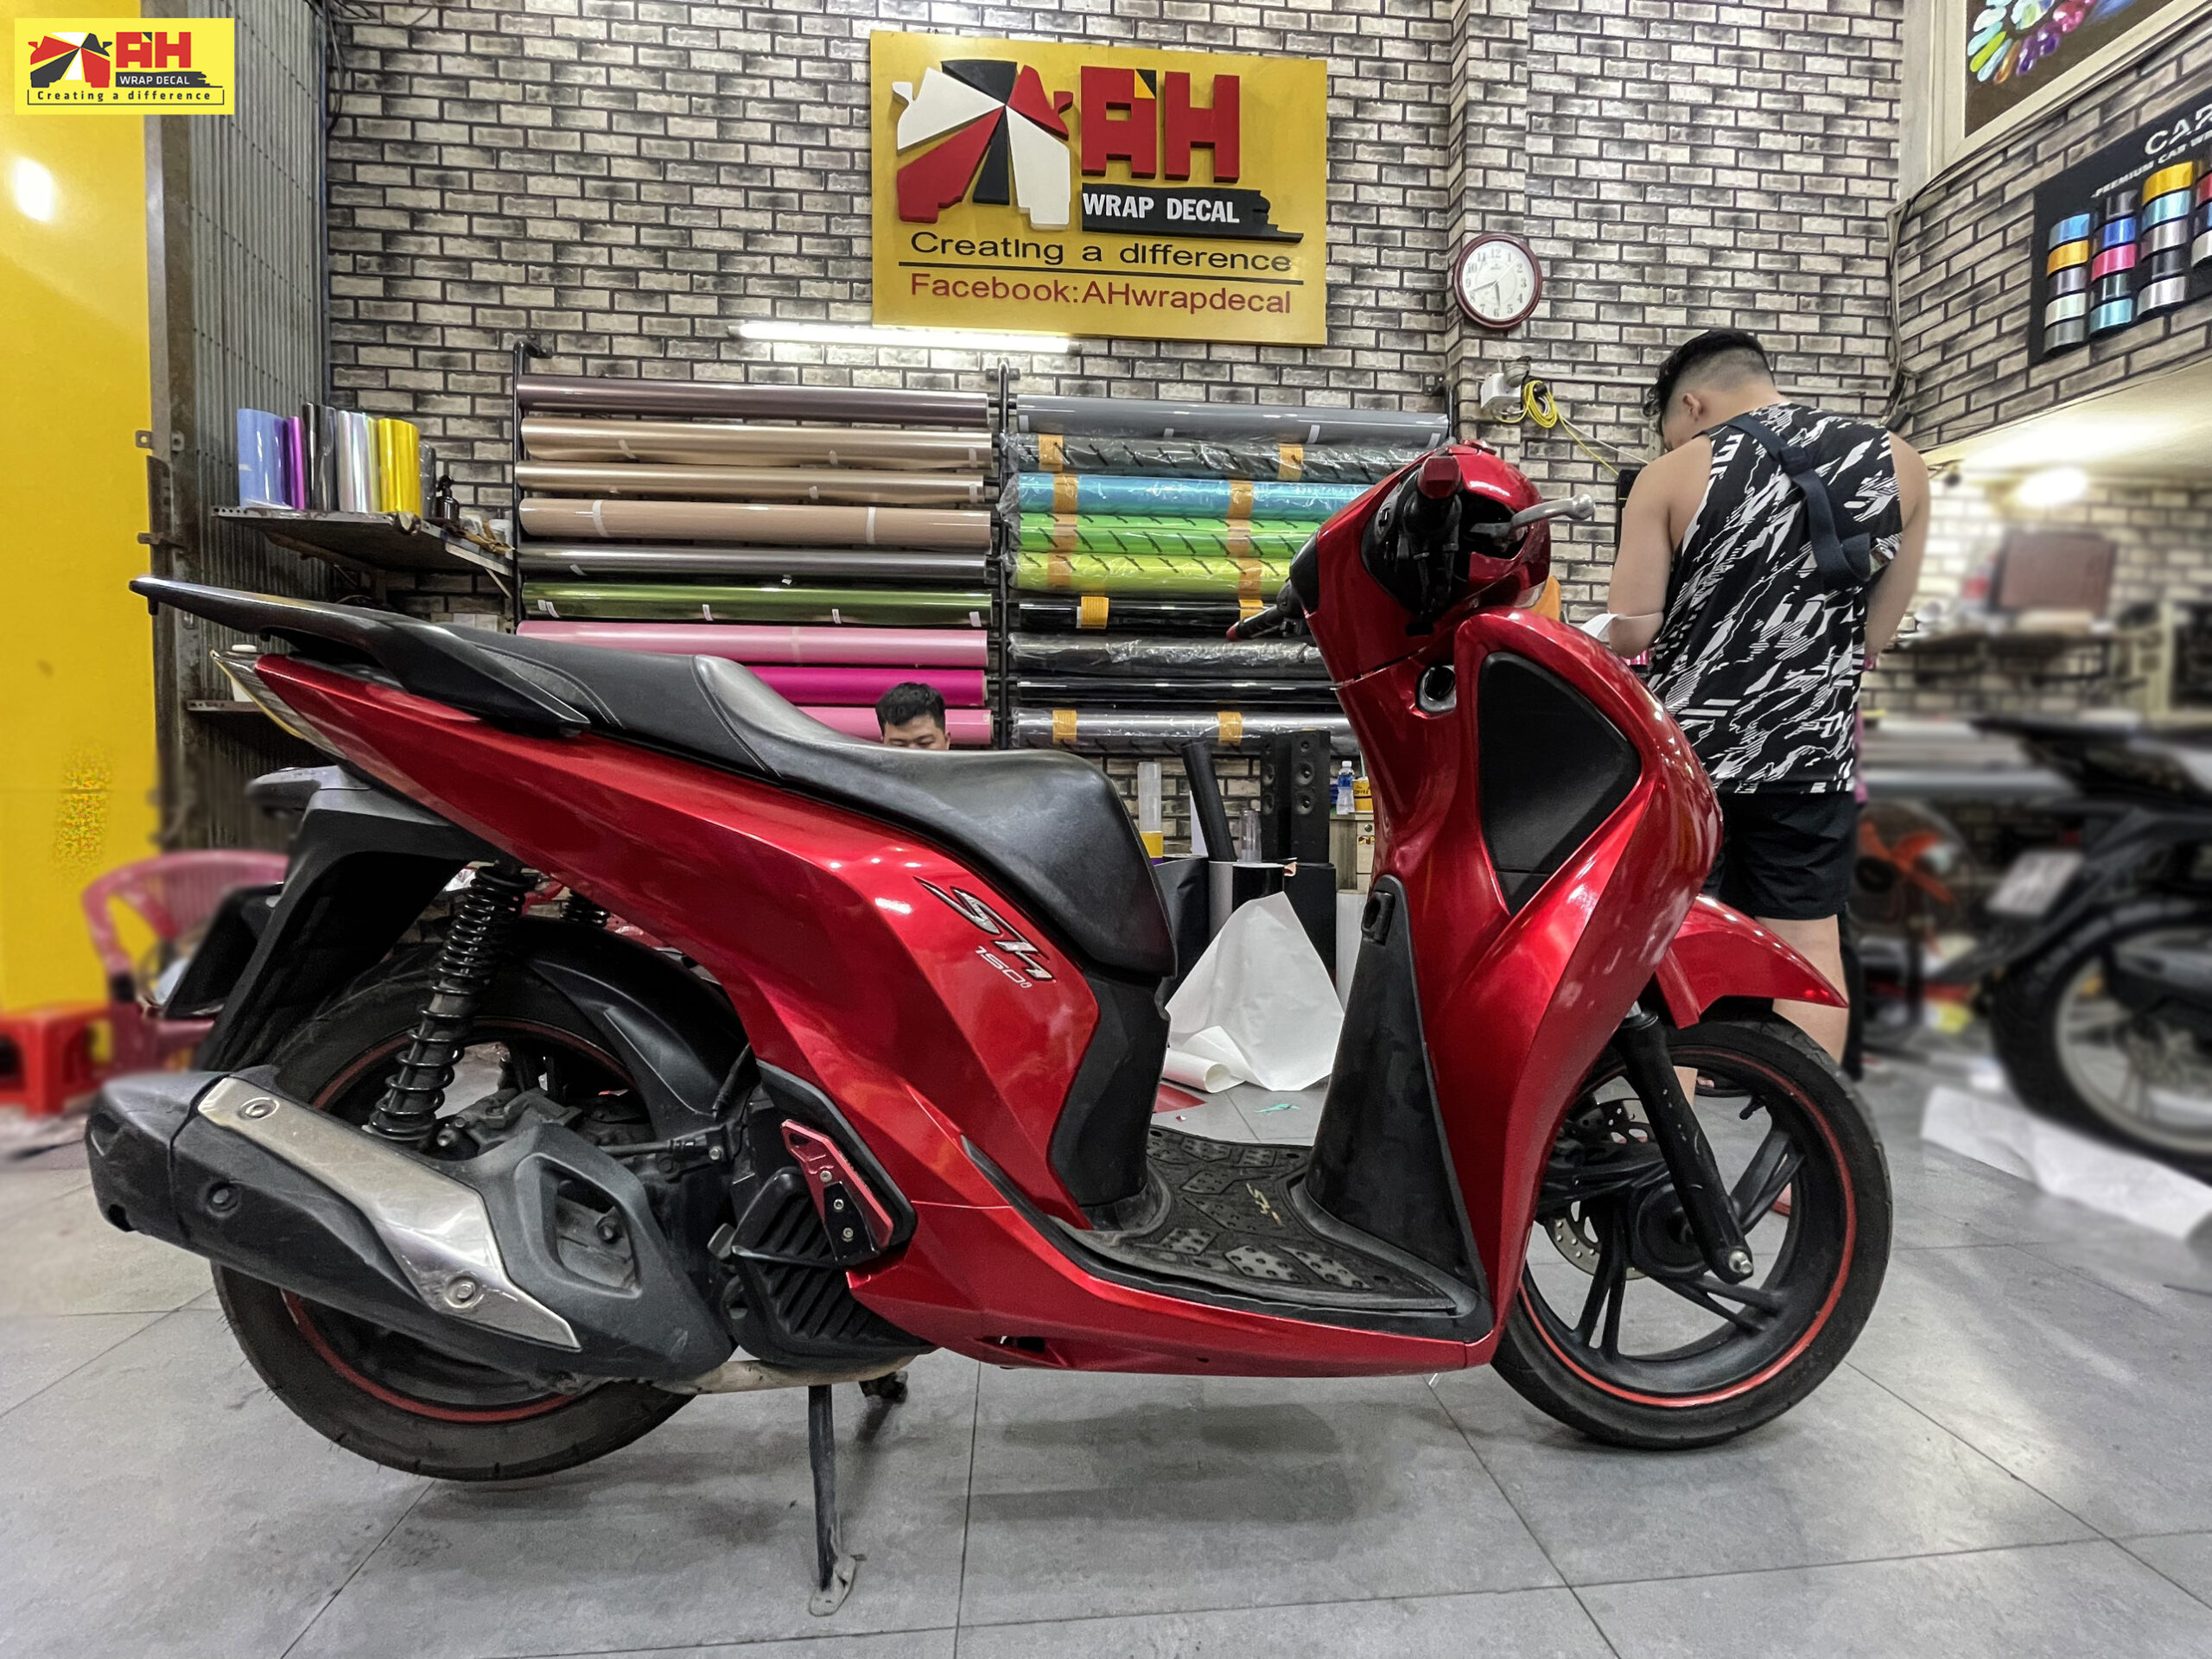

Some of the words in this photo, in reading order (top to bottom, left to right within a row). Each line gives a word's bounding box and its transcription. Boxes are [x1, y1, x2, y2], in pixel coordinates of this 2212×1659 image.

[1080, 66, 1241, 183] AH
[1082, 192, 1154, 219] WRAP
[1166, 197, 1240, 224] DECAL
[911, 231, 1064, 265] Creating
[1082, 245, 1103, 262] a
[1119, 243, 1293, 272] difference
[911, 272, 1291, 315] Facebook:AHwrapdecal
